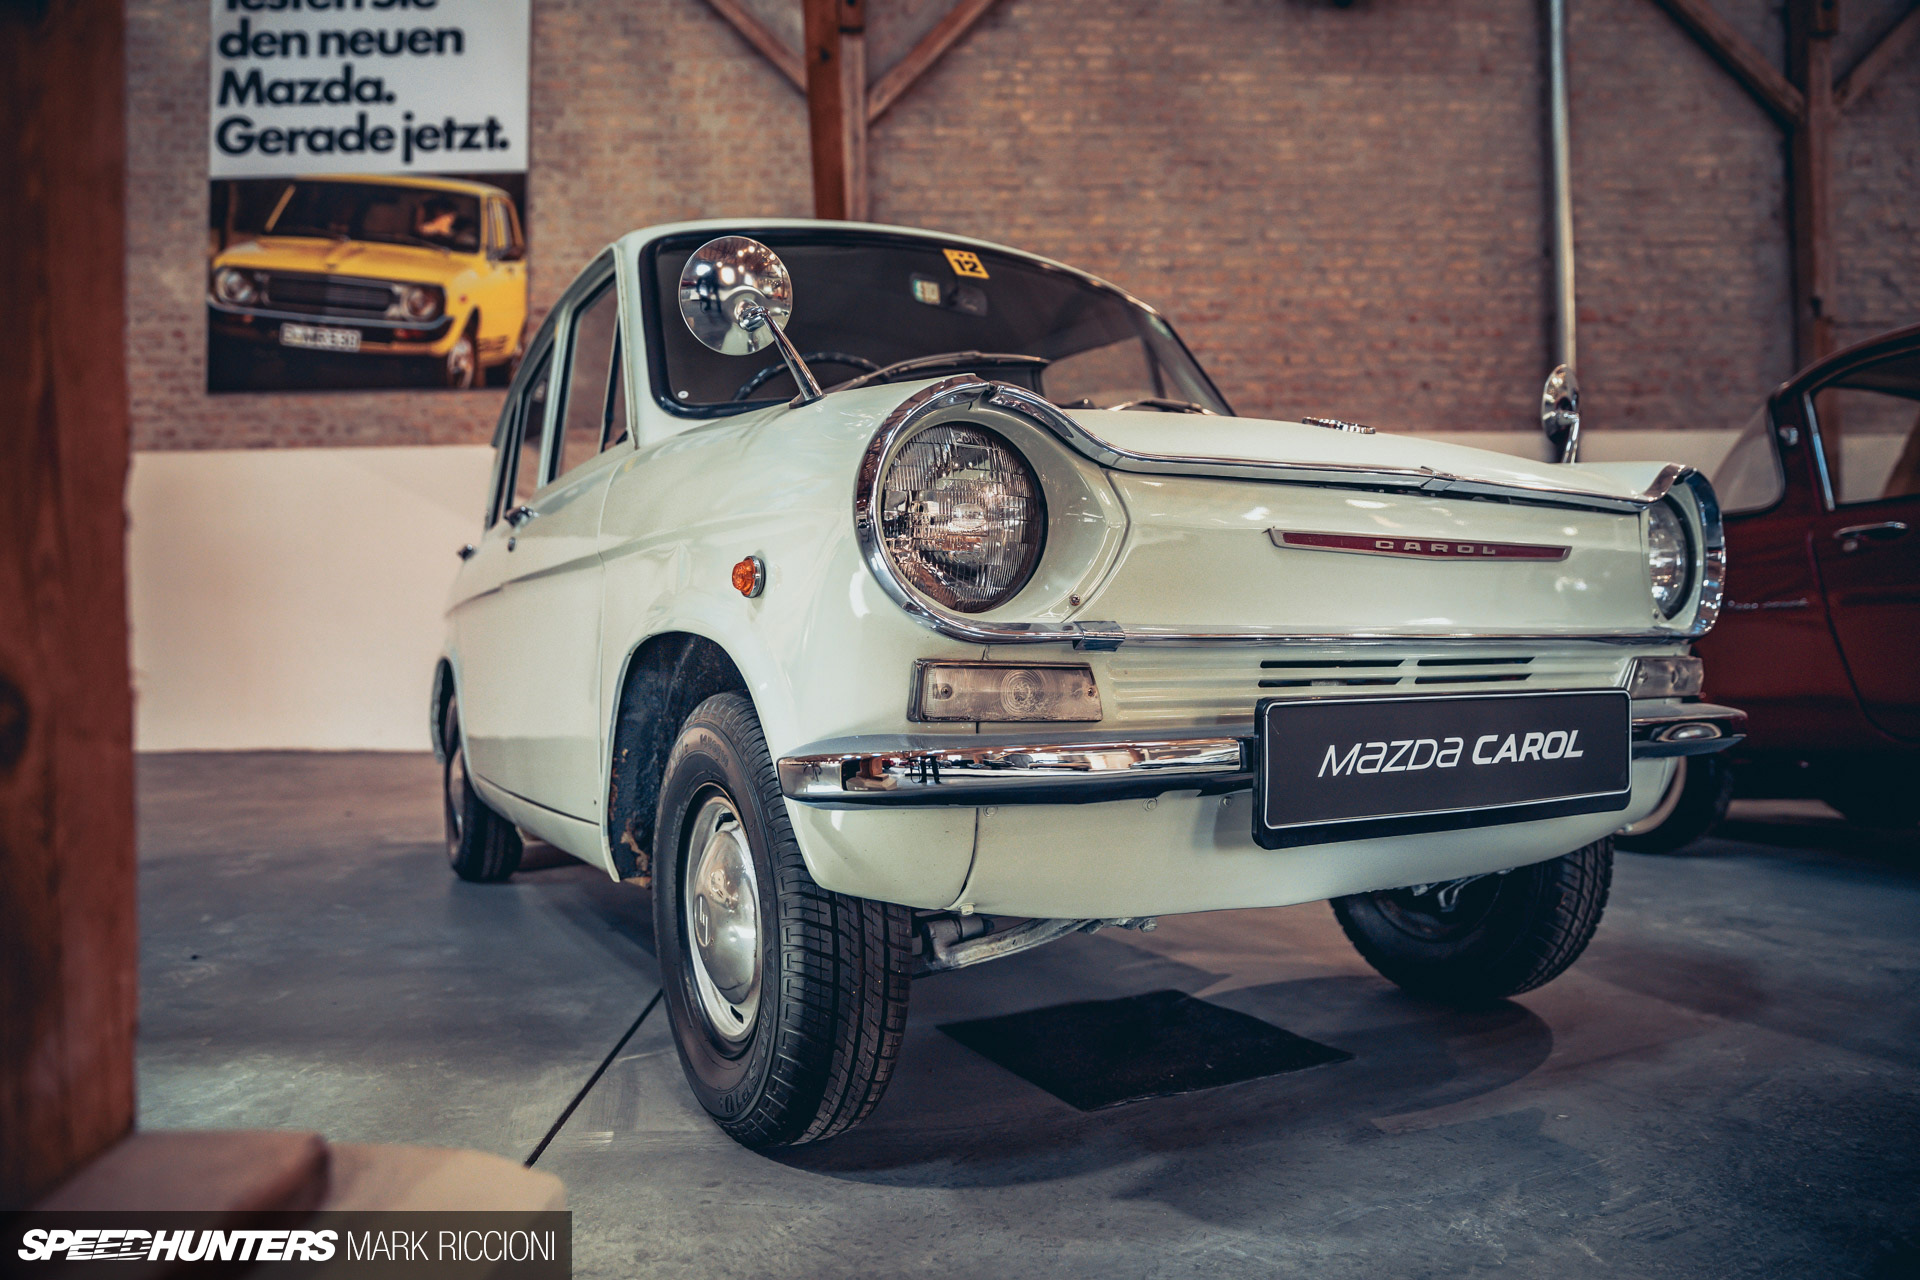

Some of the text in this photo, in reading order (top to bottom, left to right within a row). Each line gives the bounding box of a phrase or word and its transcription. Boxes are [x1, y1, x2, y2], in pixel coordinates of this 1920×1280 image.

[217, 17, 463, 59] den neuen
[218, 64, 396, 107] Mazda.
[216, 112, 509, 164] Gerade jetzt.
[953, 258, 983, 273] 12
[1375, 540, 1496, 555] CAROL
[1472, 730, 1584, 765] CAROL
